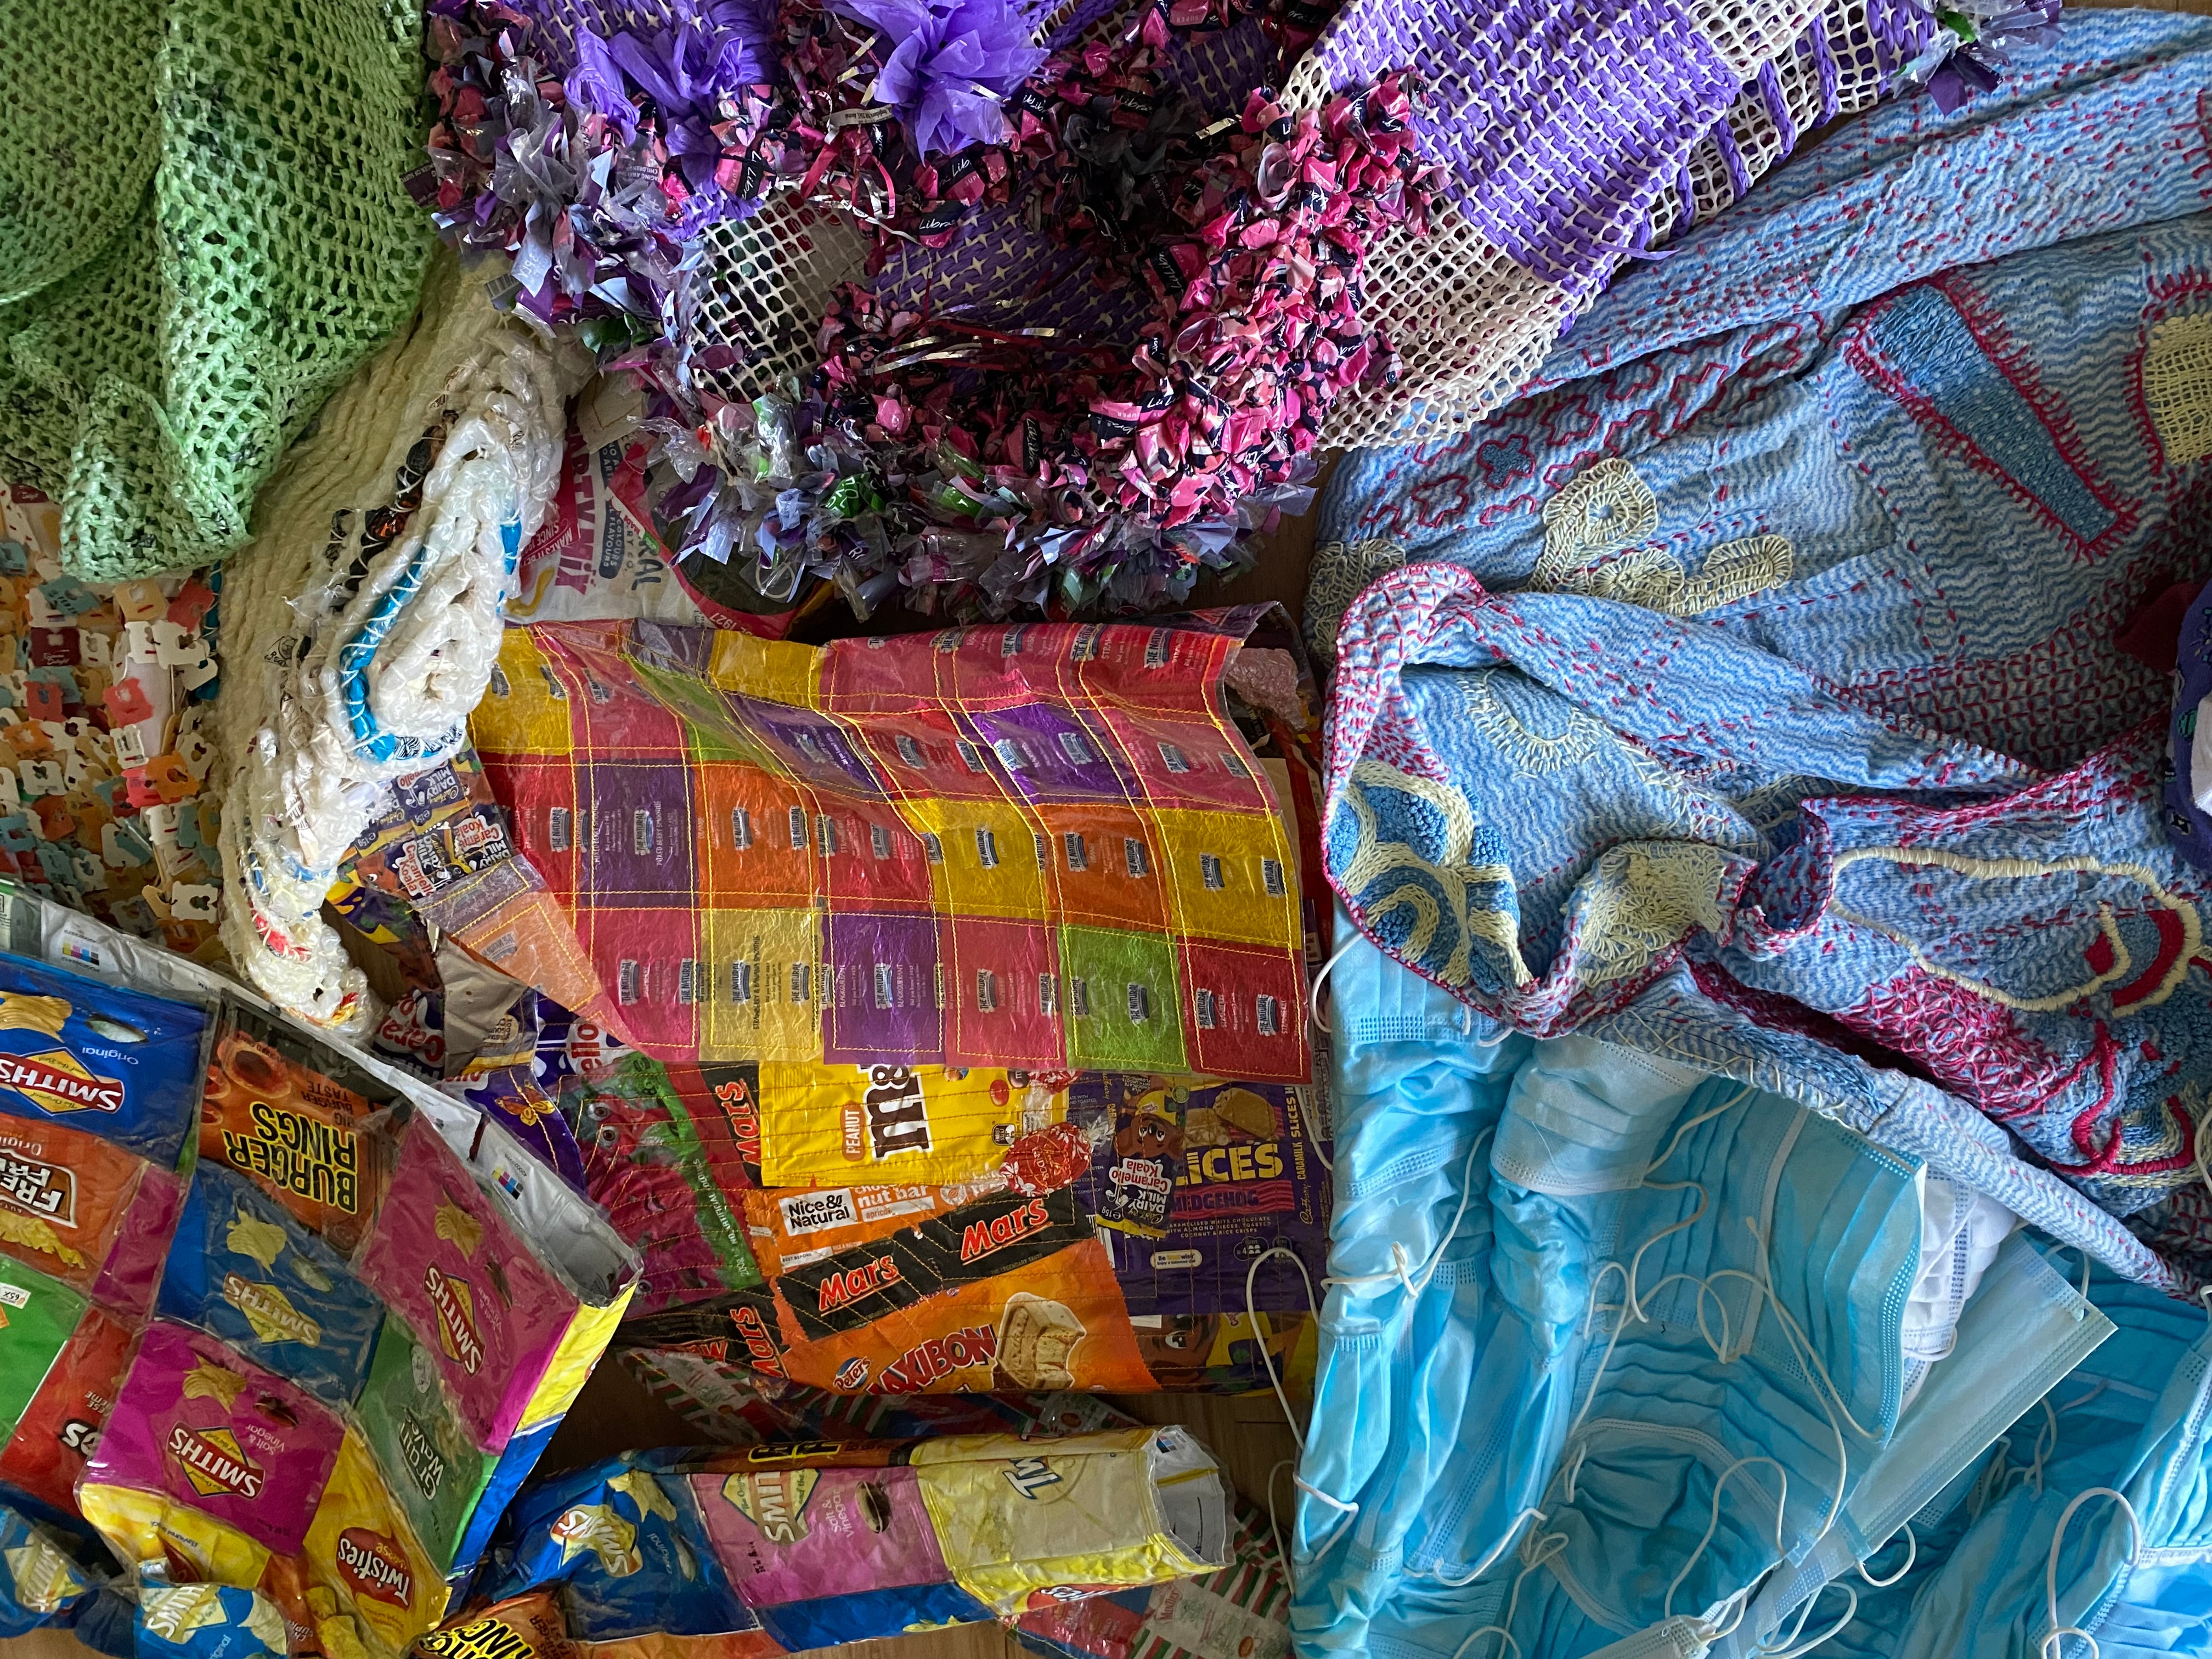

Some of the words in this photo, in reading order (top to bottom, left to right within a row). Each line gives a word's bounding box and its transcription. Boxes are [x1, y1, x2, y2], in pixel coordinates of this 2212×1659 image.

[603, 516, 617, 568] FLAVOURS
[610, 519, 622, 566] COLOURS
[425, 766, 452, 785] MILK
[426, 775, 456, 799] DAIRY
[551, 809, 563, 837] NATURAL
[636, 810, 646, 839] NATURAL
[791, 808, 802, 835] NATURAL
[416, 839, 432, 870] MILK
[482, 839, 509, 859] MILK
[976, 830, 989, 855] NATURAL
[1065, 833, 1076, 856] NATURAL
[1125, 839, 1137, 863] NATURAL
[1263, 860, 1275, 884] NATURAL
[621, 962, 631, 990] NATURAL
[681, 961, 693, 990] NATURAL
[731, 962, 742, 990] NATURAL
[791, 962, 802, 991] NATURAL
[876, 964, 885, 994] NATURAL
[978, 972, 988, 1000] NATURAL
[1128, 984, 1139, 1011] NATURAL
[1198, 991, 1207, 1016] NATURAL
[82, 1046, 139, 1065] Original
[844, 1108, 861, 1155] PEANUT
[1285, 1096, 1302, 1139] SLICES
[250, 1101, 356, 1172] RINGS
[222, 1130, 357, 1213] BURGER
[1126, 1159, 1159, 1175] Koala
[1294, 1141, 1306, 1180] CARAMILK
[1111, 1169, 1169, 1192] Caramello
[788, 1200, 825, 1218] Nice
[825, 1194, 843, 1209] &
[857, 1189, 893, 1208] nut
[894, 1184, 929, 1200] bar
[1127, 1199, 1165, 1212] DAIRY
[1138, 1189, 1167, 1204] MILK
[789, 1205, 850, 1229] Natural
[961, 1198, 1049, 1261] Mars
[1183, 1224, 1215, 1233] ALMOND
[1180, 1231, 1211, 1239] COCONUT
[2, 1289, 20, 1301] 65%
[819, 1255, 899, 1312] Mars
[226, 1276, 320, 1345] SMITH'S
[425, 1267, 483, 1375] SMITH'S
[866, 1324, 998, 1395] AXIBON
[833, 1356, 872, 1392] Peters
[245, 1424, 285, 1453] Vinegar
[257, 1440, 276, 1455] Salt
[169, 1428, 262, 1497] SMITH'S
[825, 1509, 842, 1533] Salt
[832, 1488, 855, 1538] Vinegar
[338, 1537, 411, 1606] Twisties
